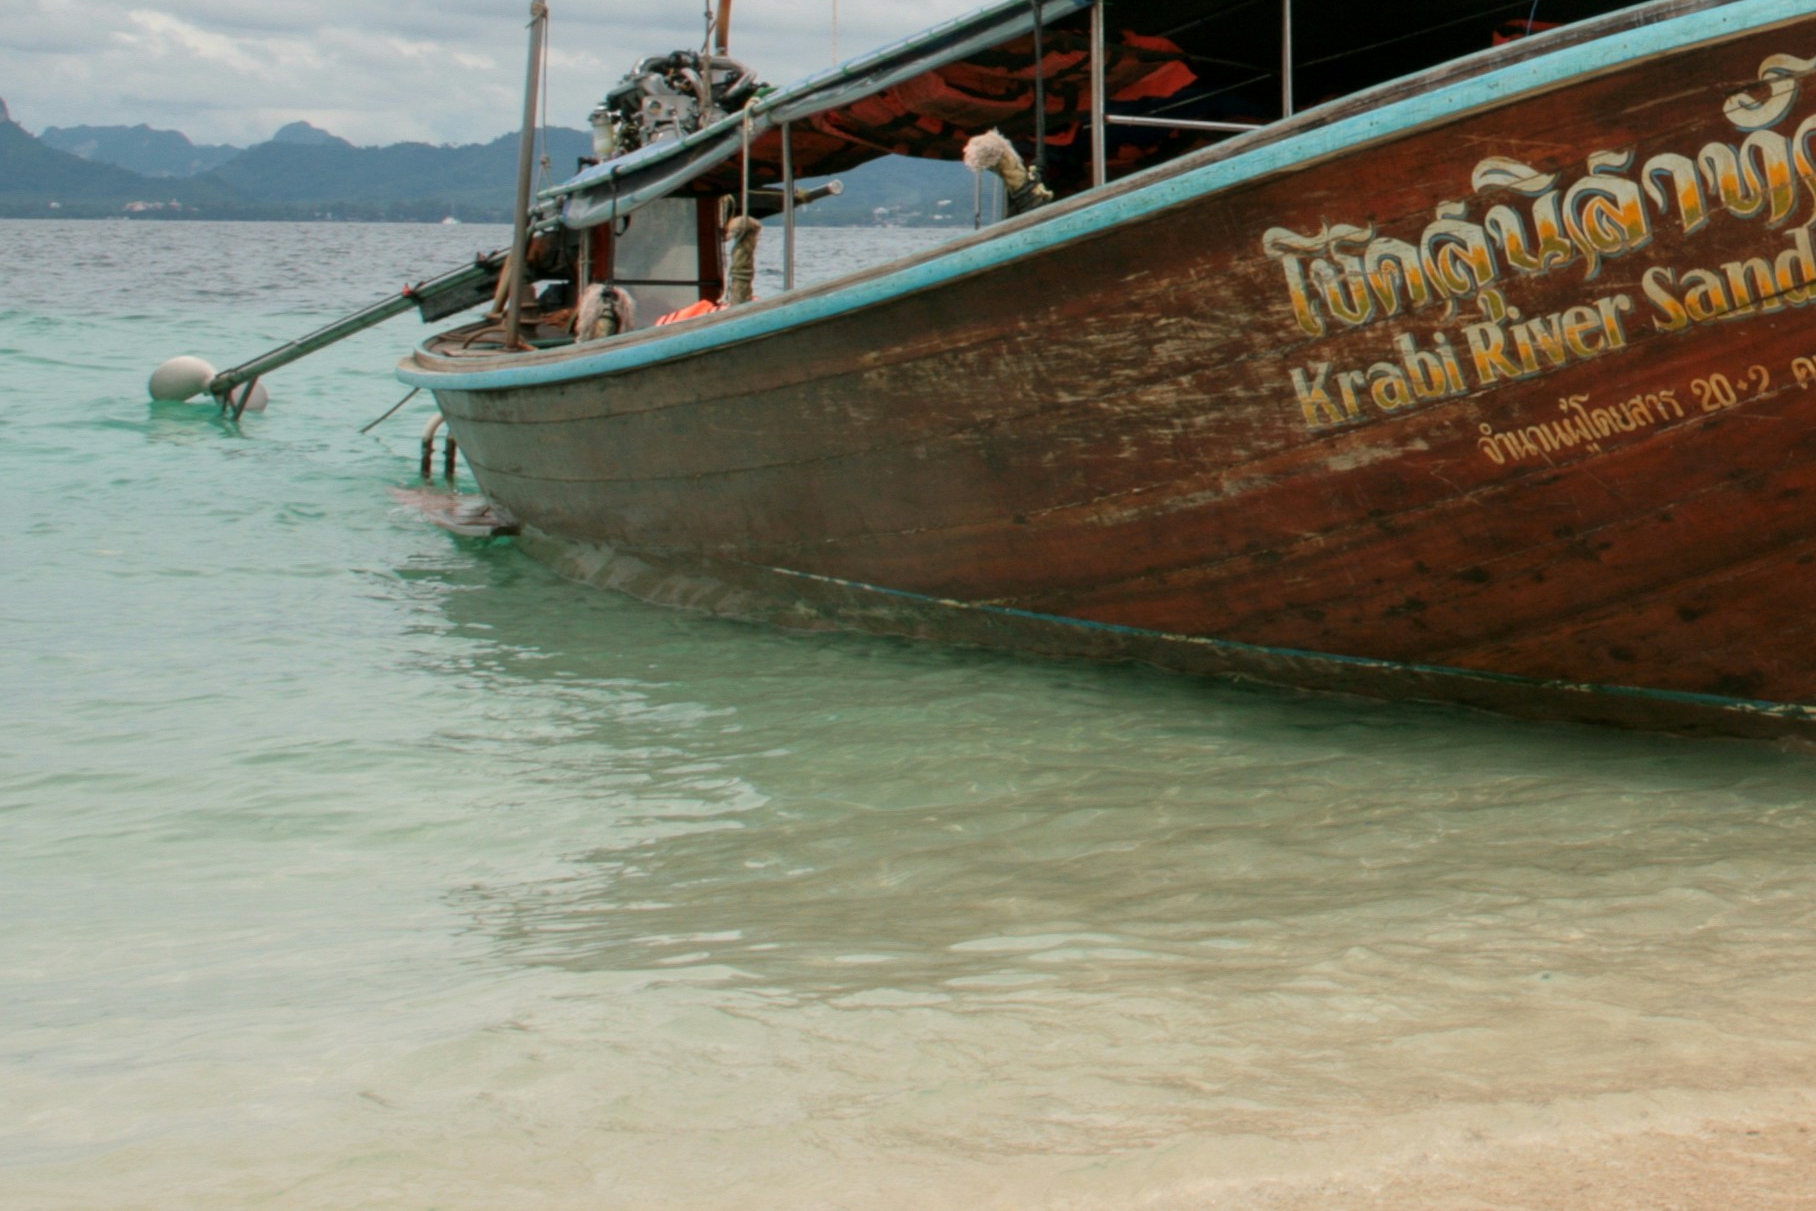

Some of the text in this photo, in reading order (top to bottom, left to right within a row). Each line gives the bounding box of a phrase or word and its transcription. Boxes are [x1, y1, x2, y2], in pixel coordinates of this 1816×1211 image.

[1288, 332, 1468, 432] Krabi
[1461, 293, 1633, 386] River
[1477, 393, 1686, 466] จำนวนผู้โดยสาร
